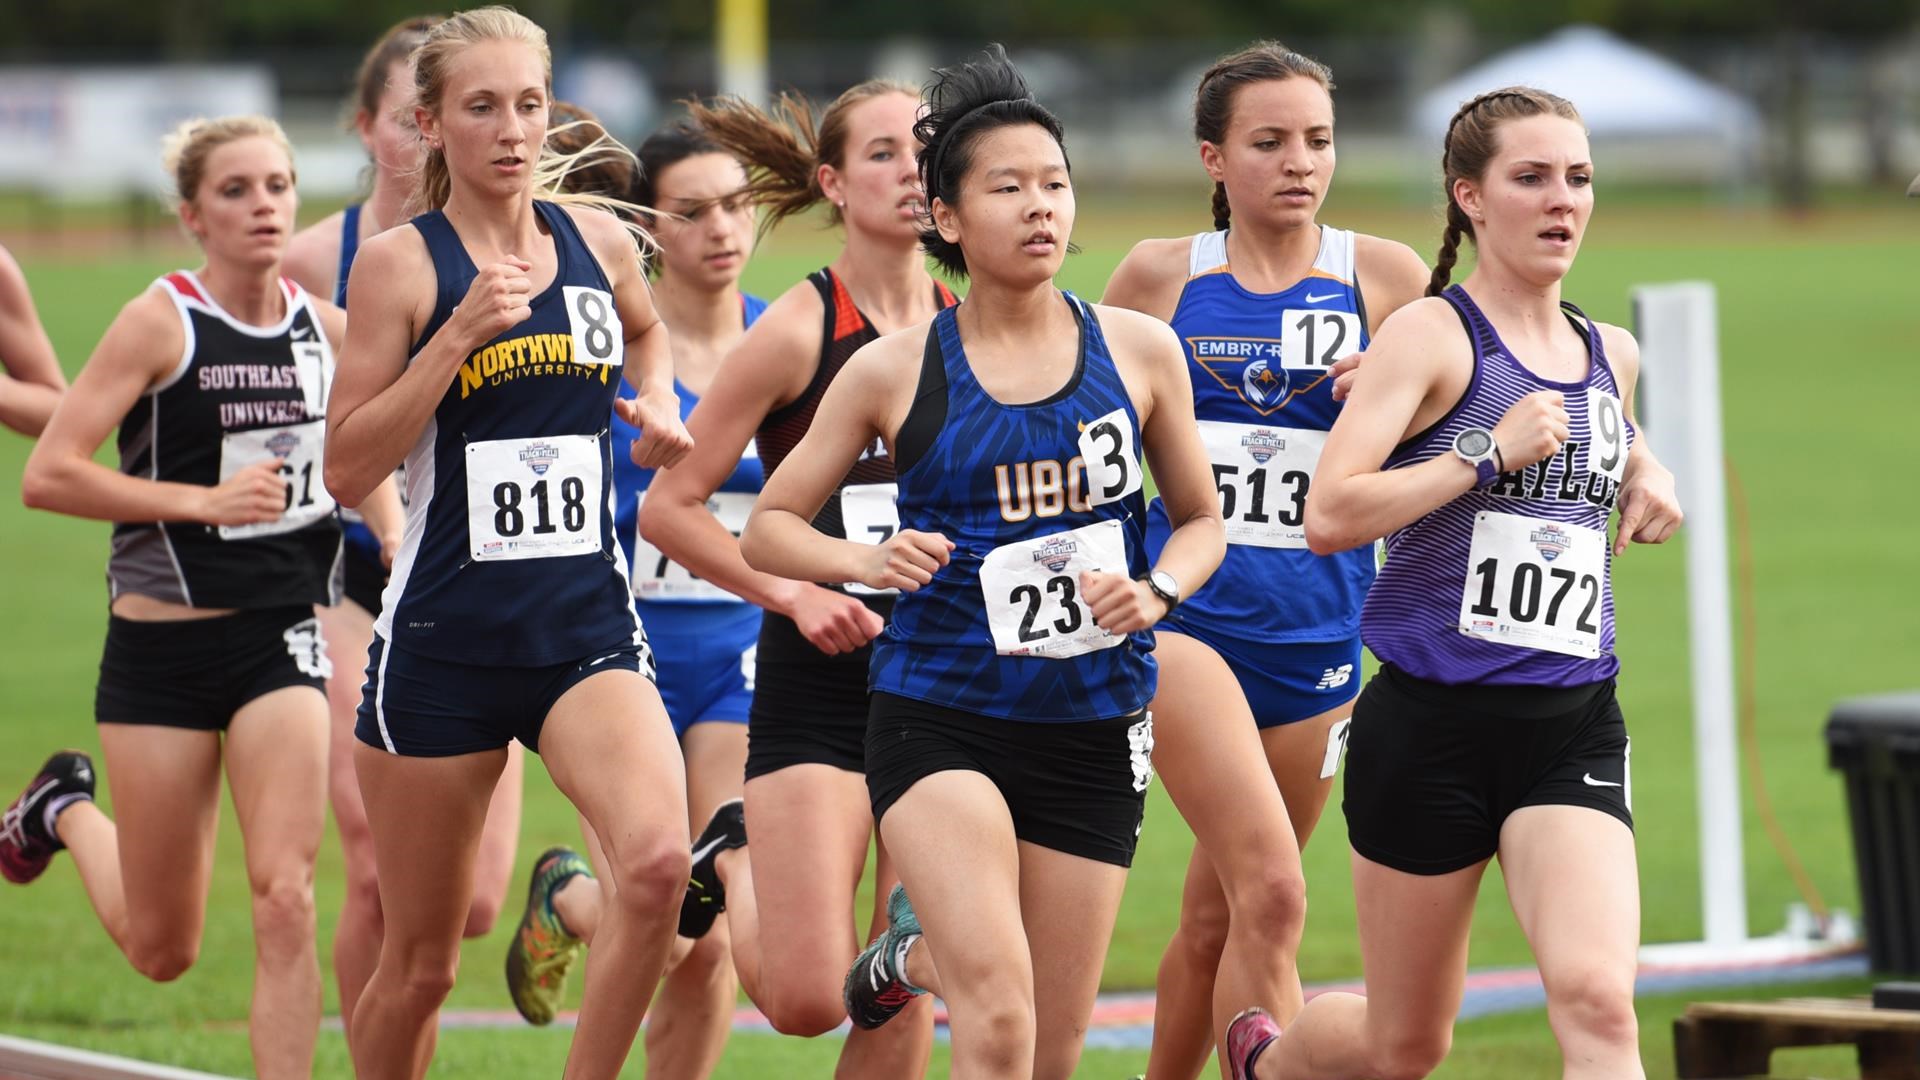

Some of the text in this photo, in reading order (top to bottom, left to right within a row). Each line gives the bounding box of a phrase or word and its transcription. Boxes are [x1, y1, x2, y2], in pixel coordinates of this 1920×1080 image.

[577, 291, 613, 358] 8
[1296, 314, 1346, 366] 12
[305, 350, 323, 408] 7
[459, 333, 614, 400] NORTHWT
[492, 364, 592, 386] UNIVERSITY
[1089, 421, 1127, 498] 3
[1598, 396, 1620, 472] 9
[493, 476, 585, 537] 818
[995, 455, 1092, 523] UBC
[1211, 463, 1310, 527] 513
[1010, 568, 1101, 643] 23
[1471, 557, 1598, 634] 1072
